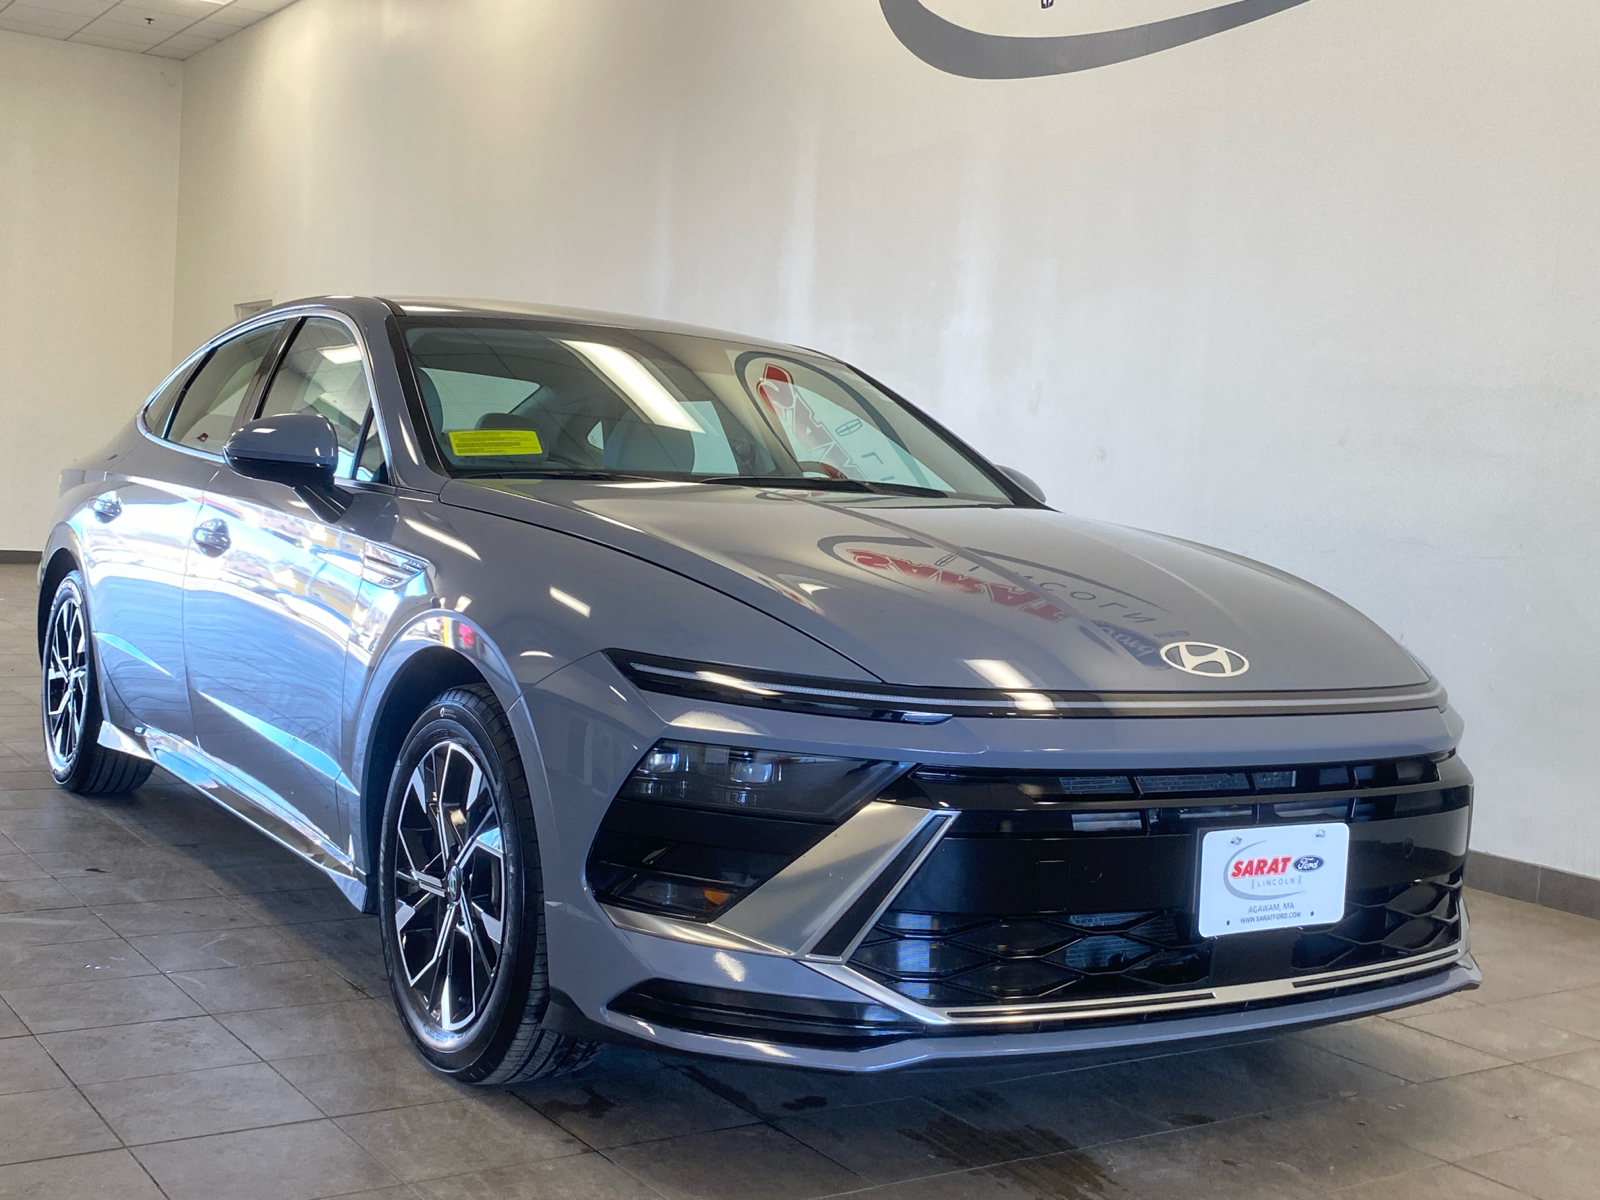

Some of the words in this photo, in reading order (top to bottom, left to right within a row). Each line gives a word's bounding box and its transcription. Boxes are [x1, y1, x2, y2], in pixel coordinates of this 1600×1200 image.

[1231, 856, 1292, 878] SARAT
[1297, 857, 1320, 871] Ford
[1257, 877, 1295, 888] LINCOLN
[1248, 904, 1281, 914] AGAWAM,
[1282, 902, 1295, 910] MA
[1240, 911, 1302, 924] WWW.SARATFORD.COM
